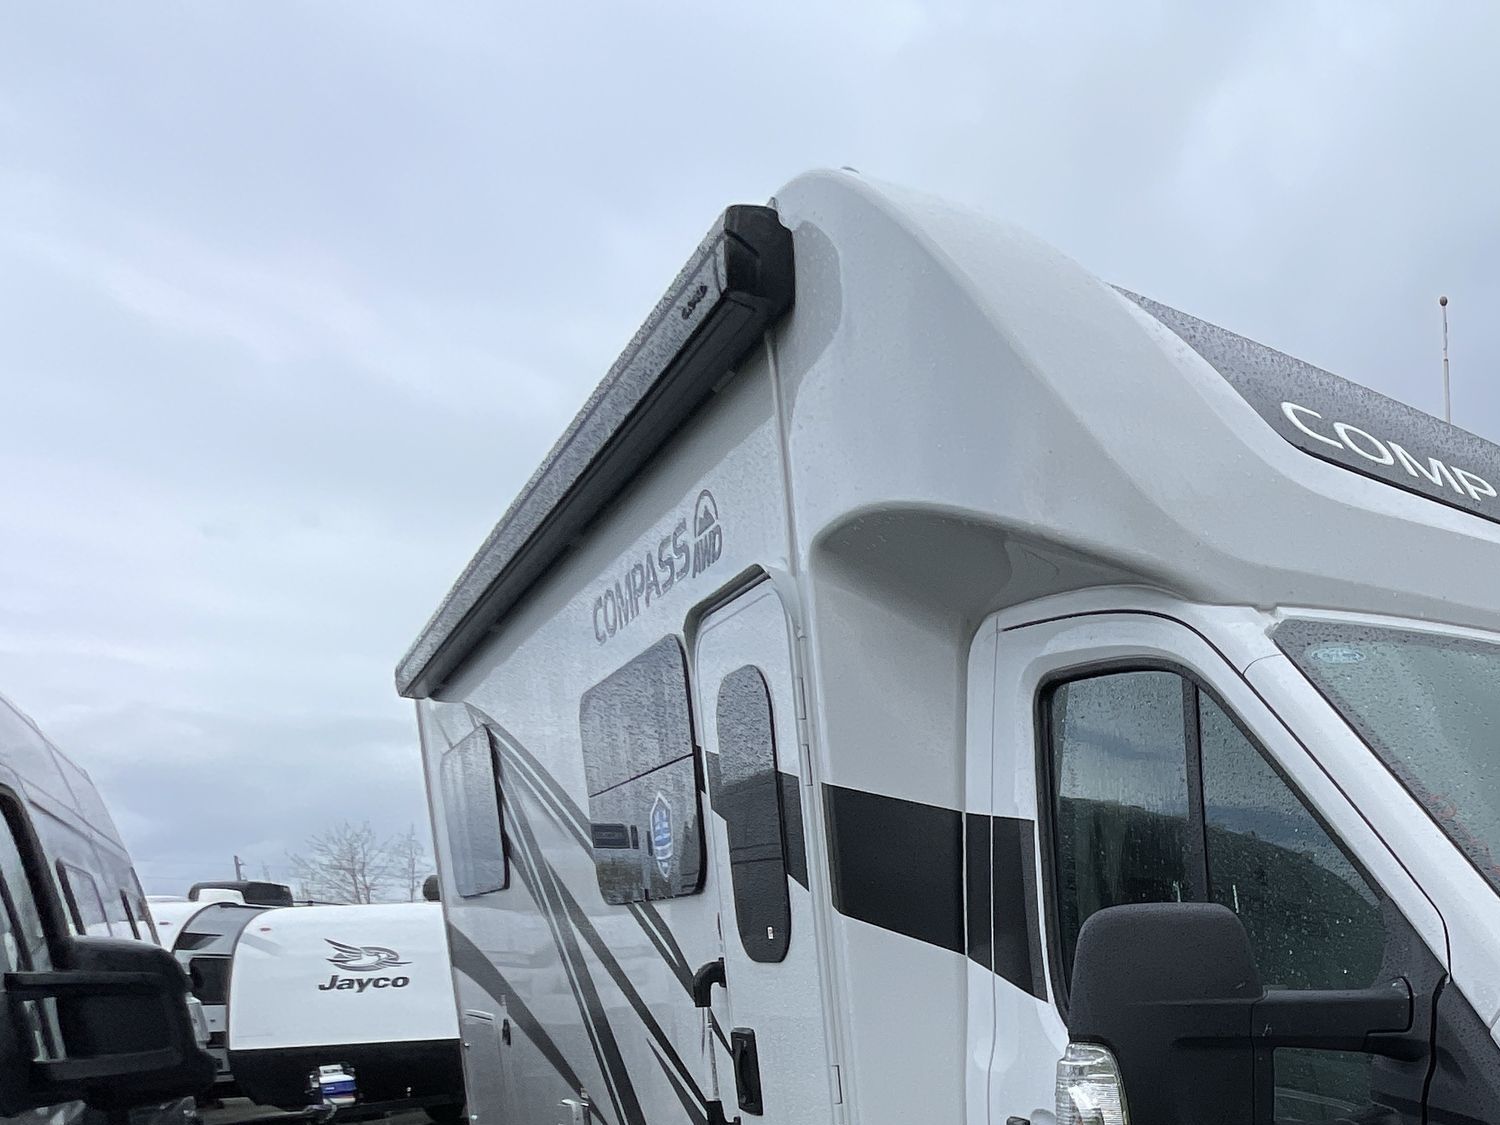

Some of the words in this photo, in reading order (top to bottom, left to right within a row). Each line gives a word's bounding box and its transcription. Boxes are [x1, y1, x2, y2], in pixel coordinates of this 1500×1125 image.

[592, 518, 690, 645] COMPASS
[692, 523, 722, 579] AWD
[318, 974, 410, 994] Jayco
